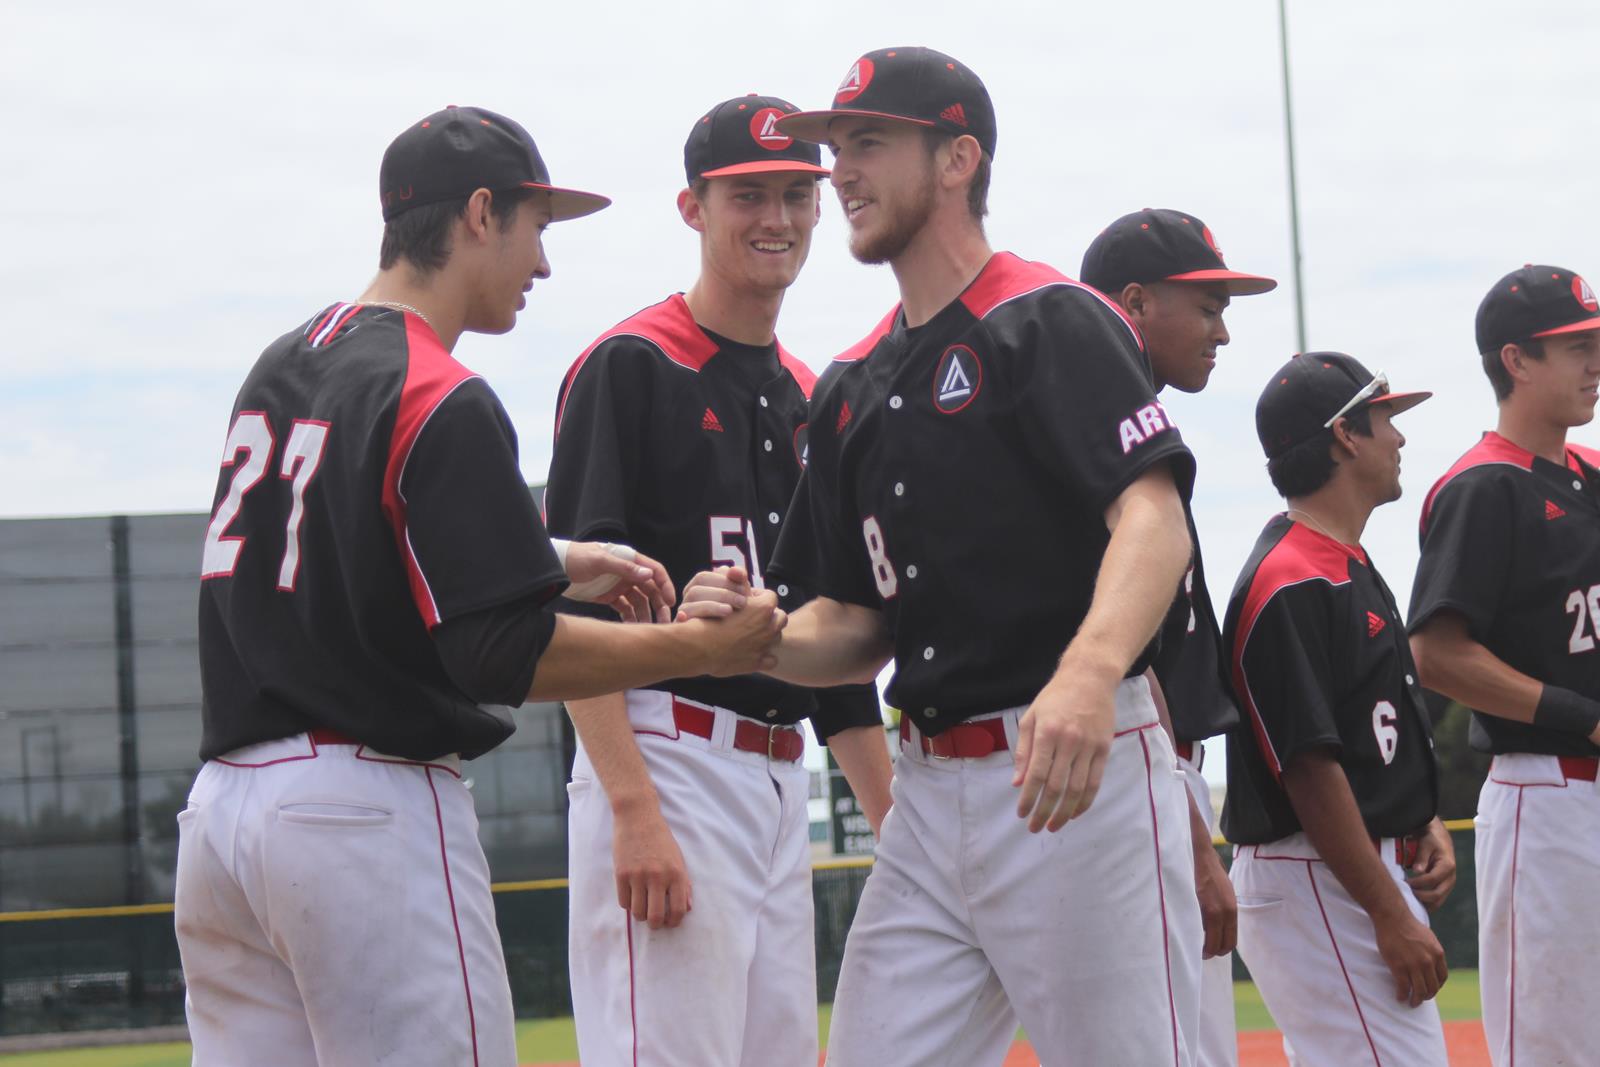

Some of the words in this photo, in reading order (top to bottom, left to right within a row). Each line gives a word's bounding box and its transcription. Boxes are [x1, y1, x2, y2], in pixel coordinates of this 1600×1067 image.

[200, 410, 332, 592] 27
[709, 515, 765, 590] 51
[863, 515, 898, 600] 8
[1372, 700, 1398, 766] 6
